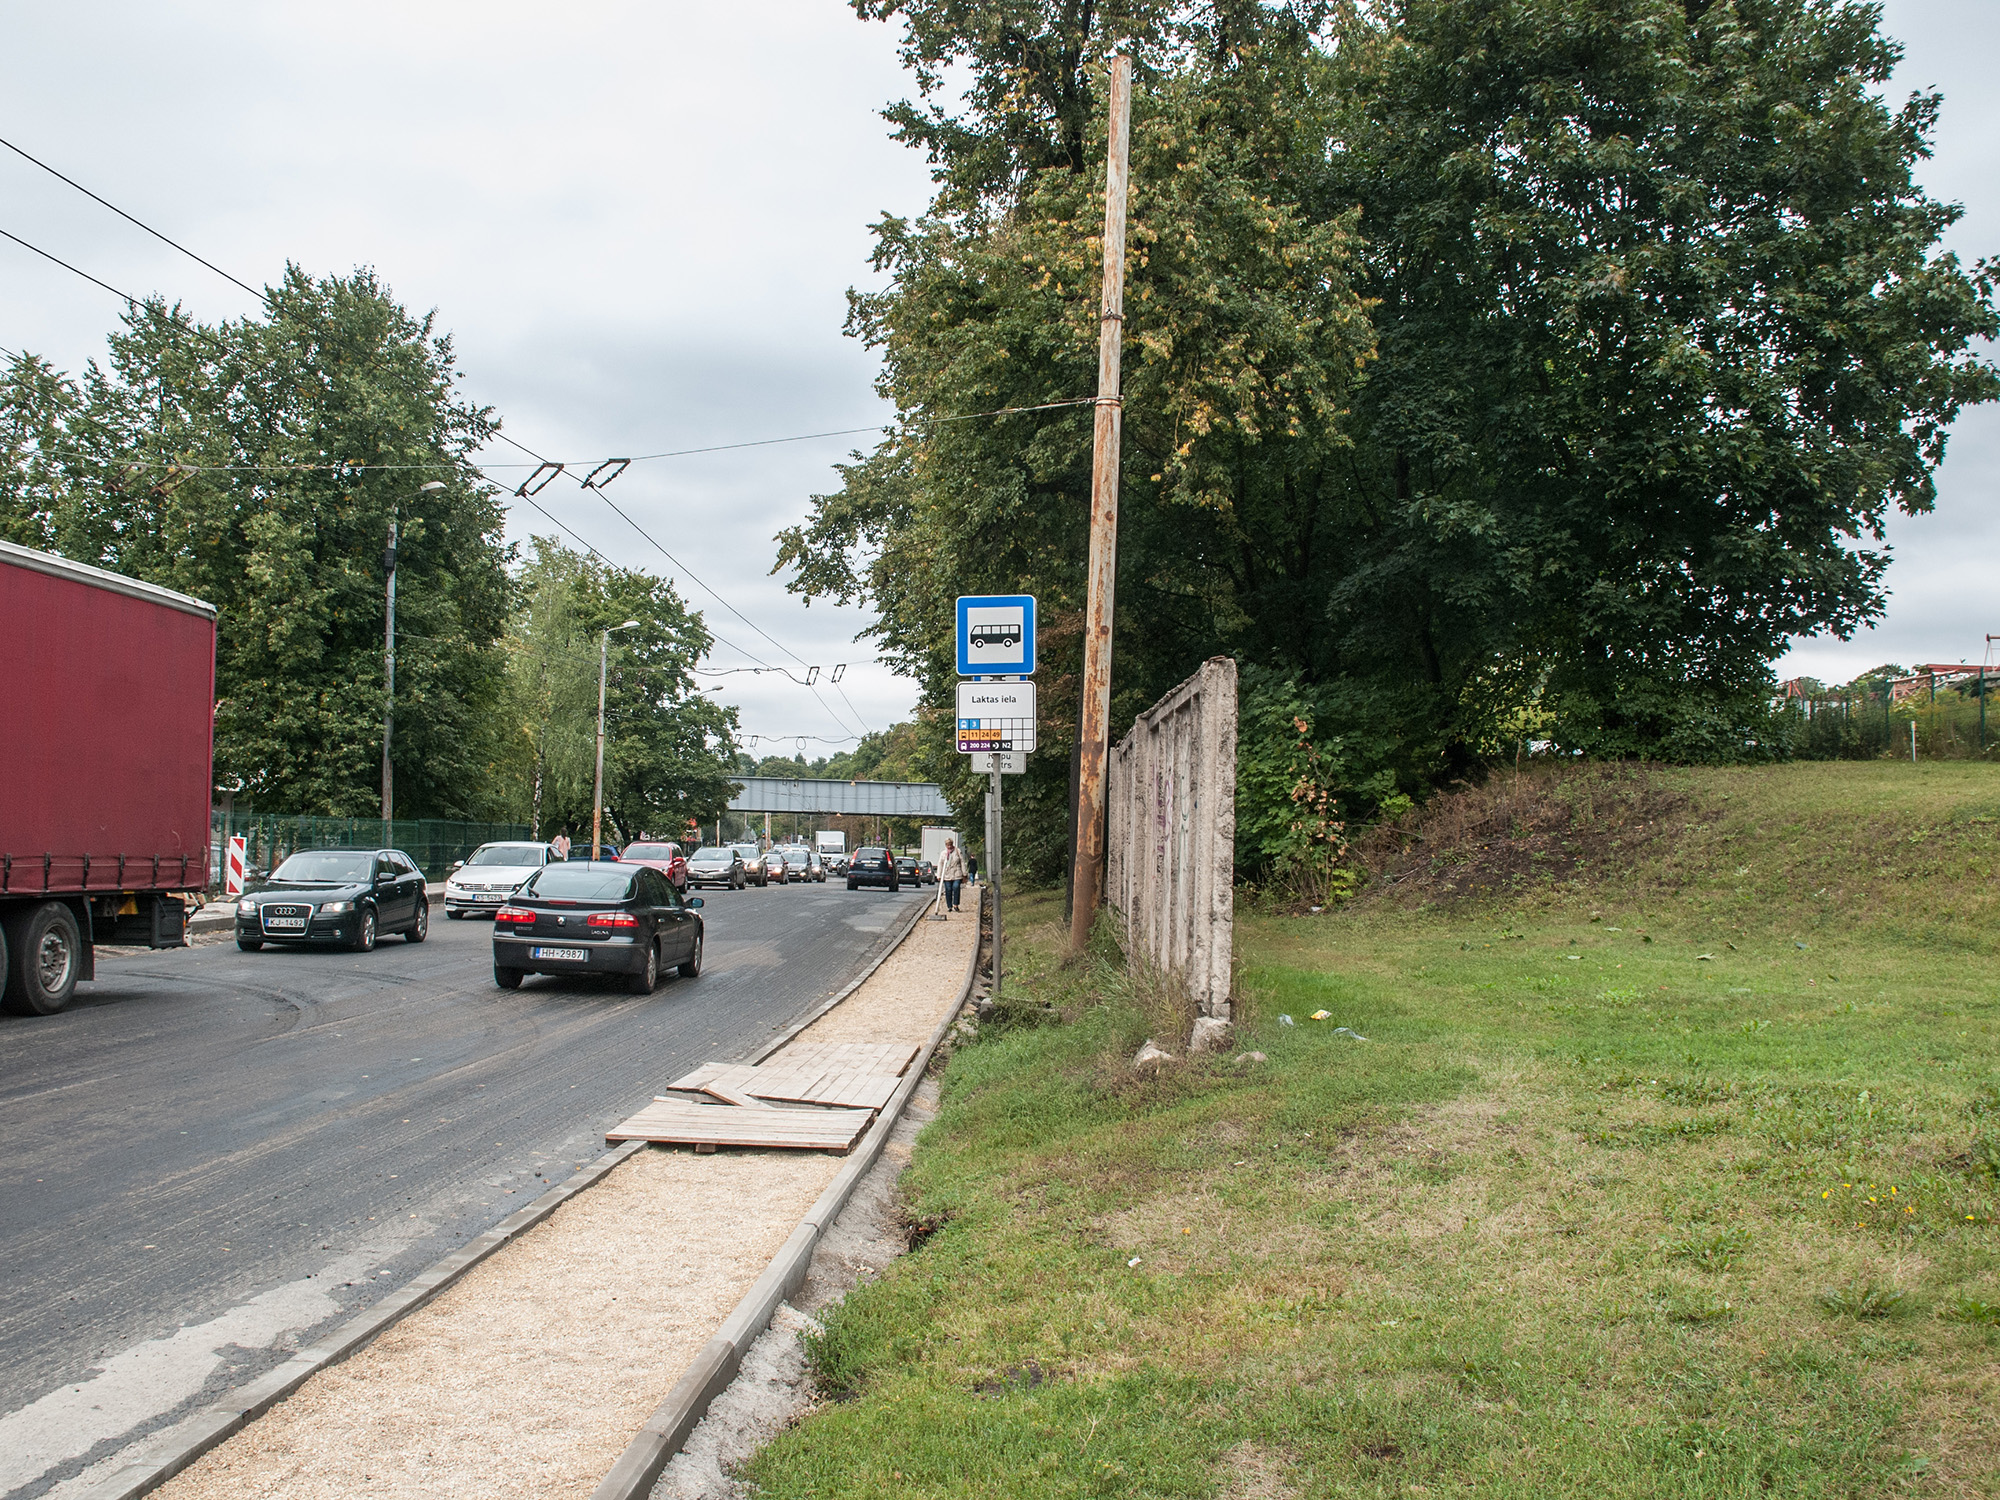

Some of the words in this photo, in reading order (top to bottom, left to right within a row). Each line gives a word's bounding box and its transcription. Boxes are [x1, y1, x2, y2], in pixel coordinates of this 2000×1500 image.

[972, 695, 999, 703] Laktas
[1001, 695, 1016, 703] iela
[988, 753, 1011, 762] Rpu
[270, 918, 303, 927] KJ-1492
[541, 948, 583, 959] HH-2987
